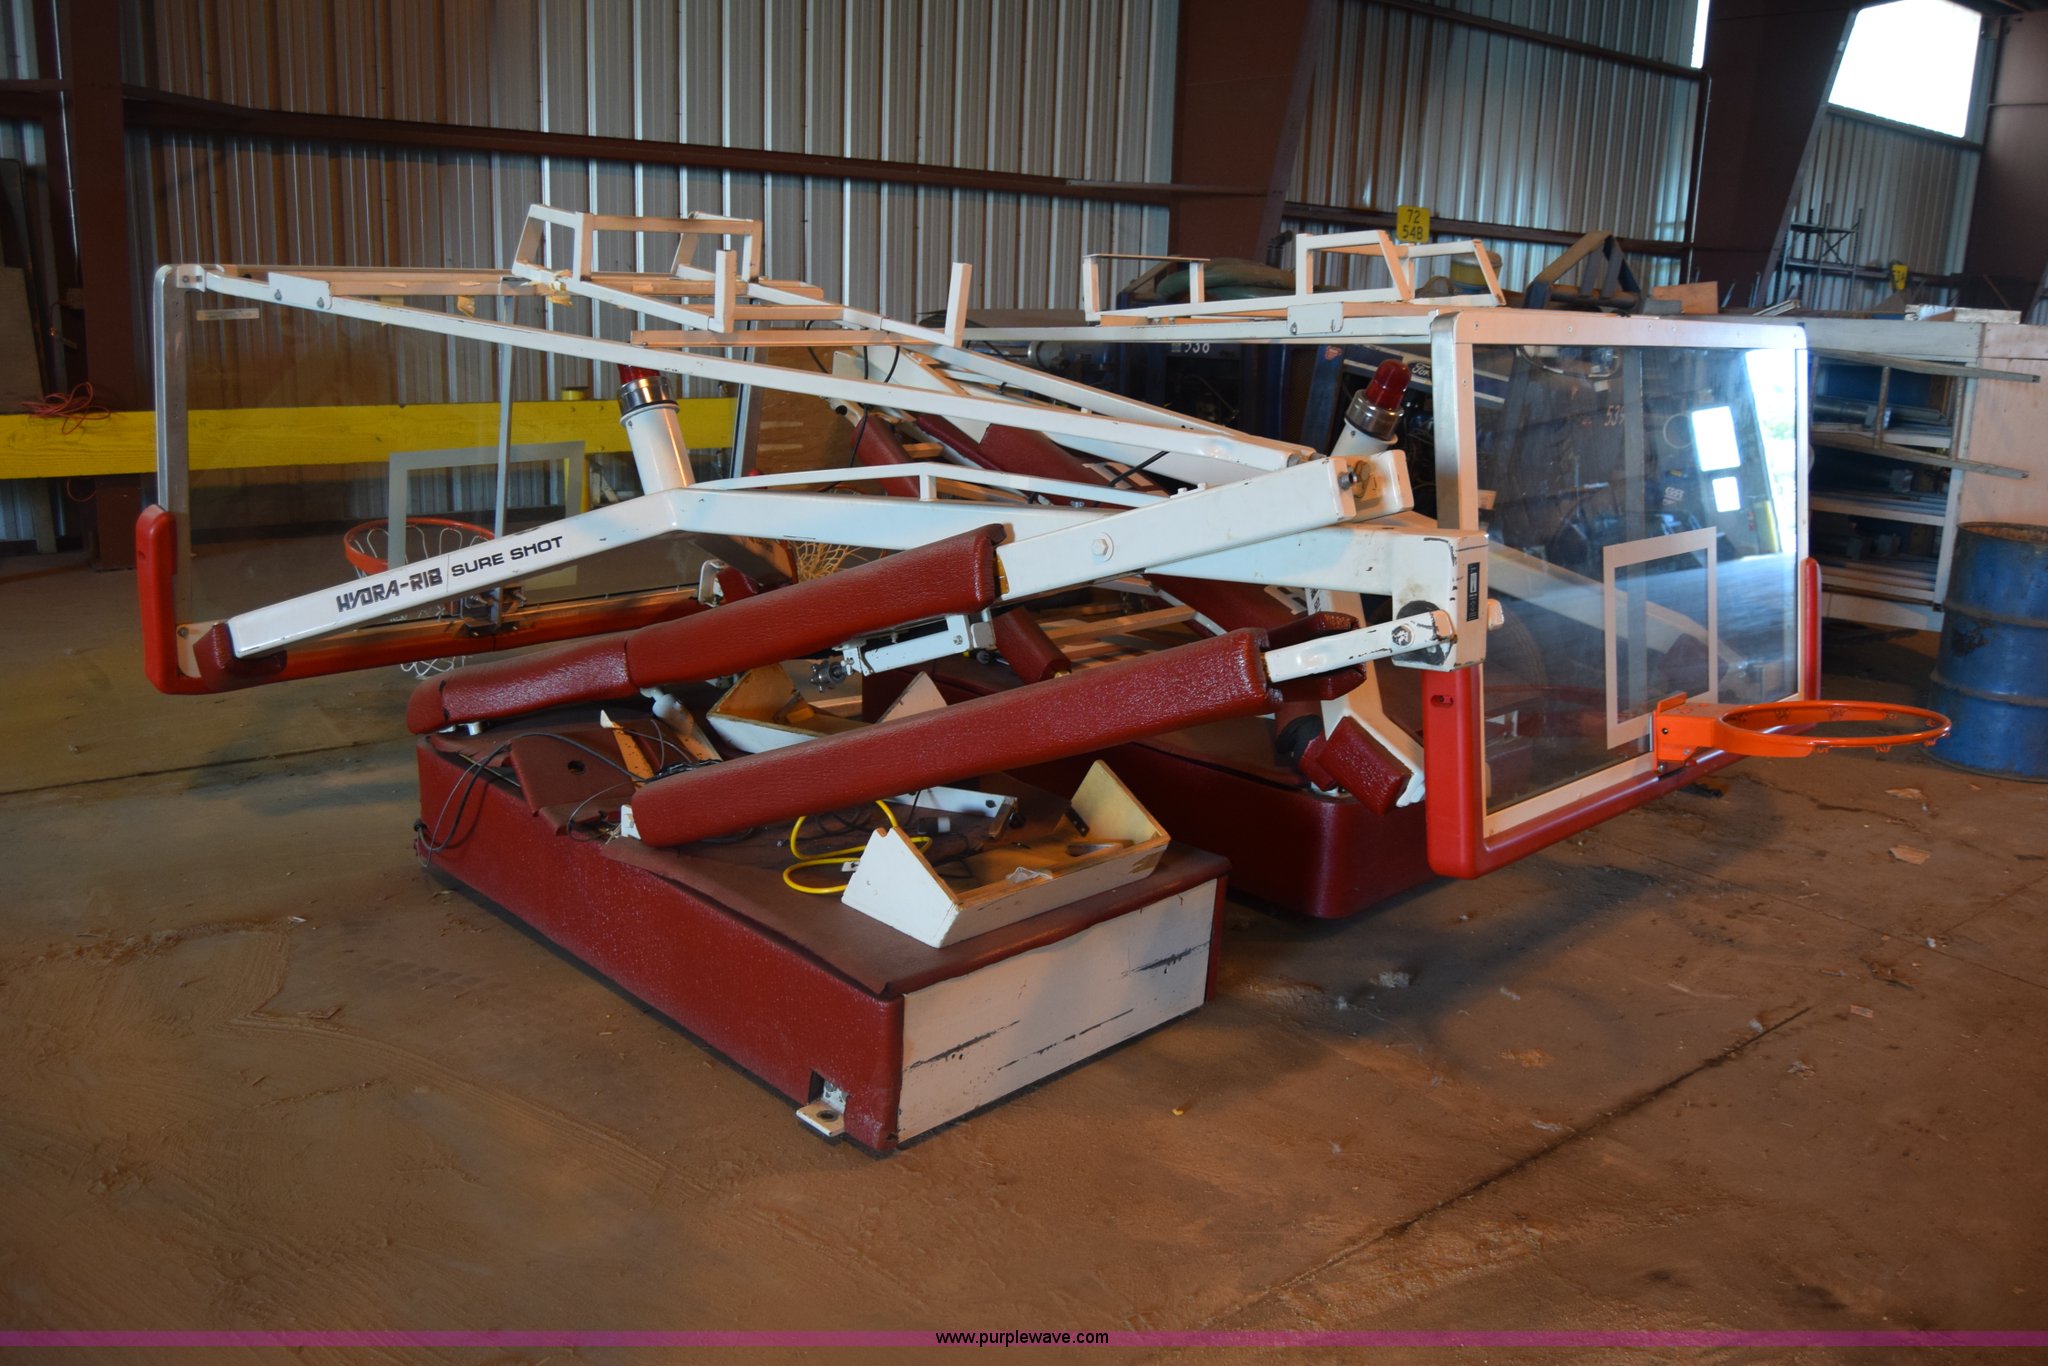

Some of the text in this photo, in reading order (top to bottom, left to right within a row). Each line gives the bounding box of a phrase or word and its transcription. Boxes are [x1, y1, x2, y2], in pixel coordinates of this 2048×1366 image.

[1407, 209, 1421, 224] 72
[336, 535, 564, 613] HYDRA-RIB SURE SHOT
